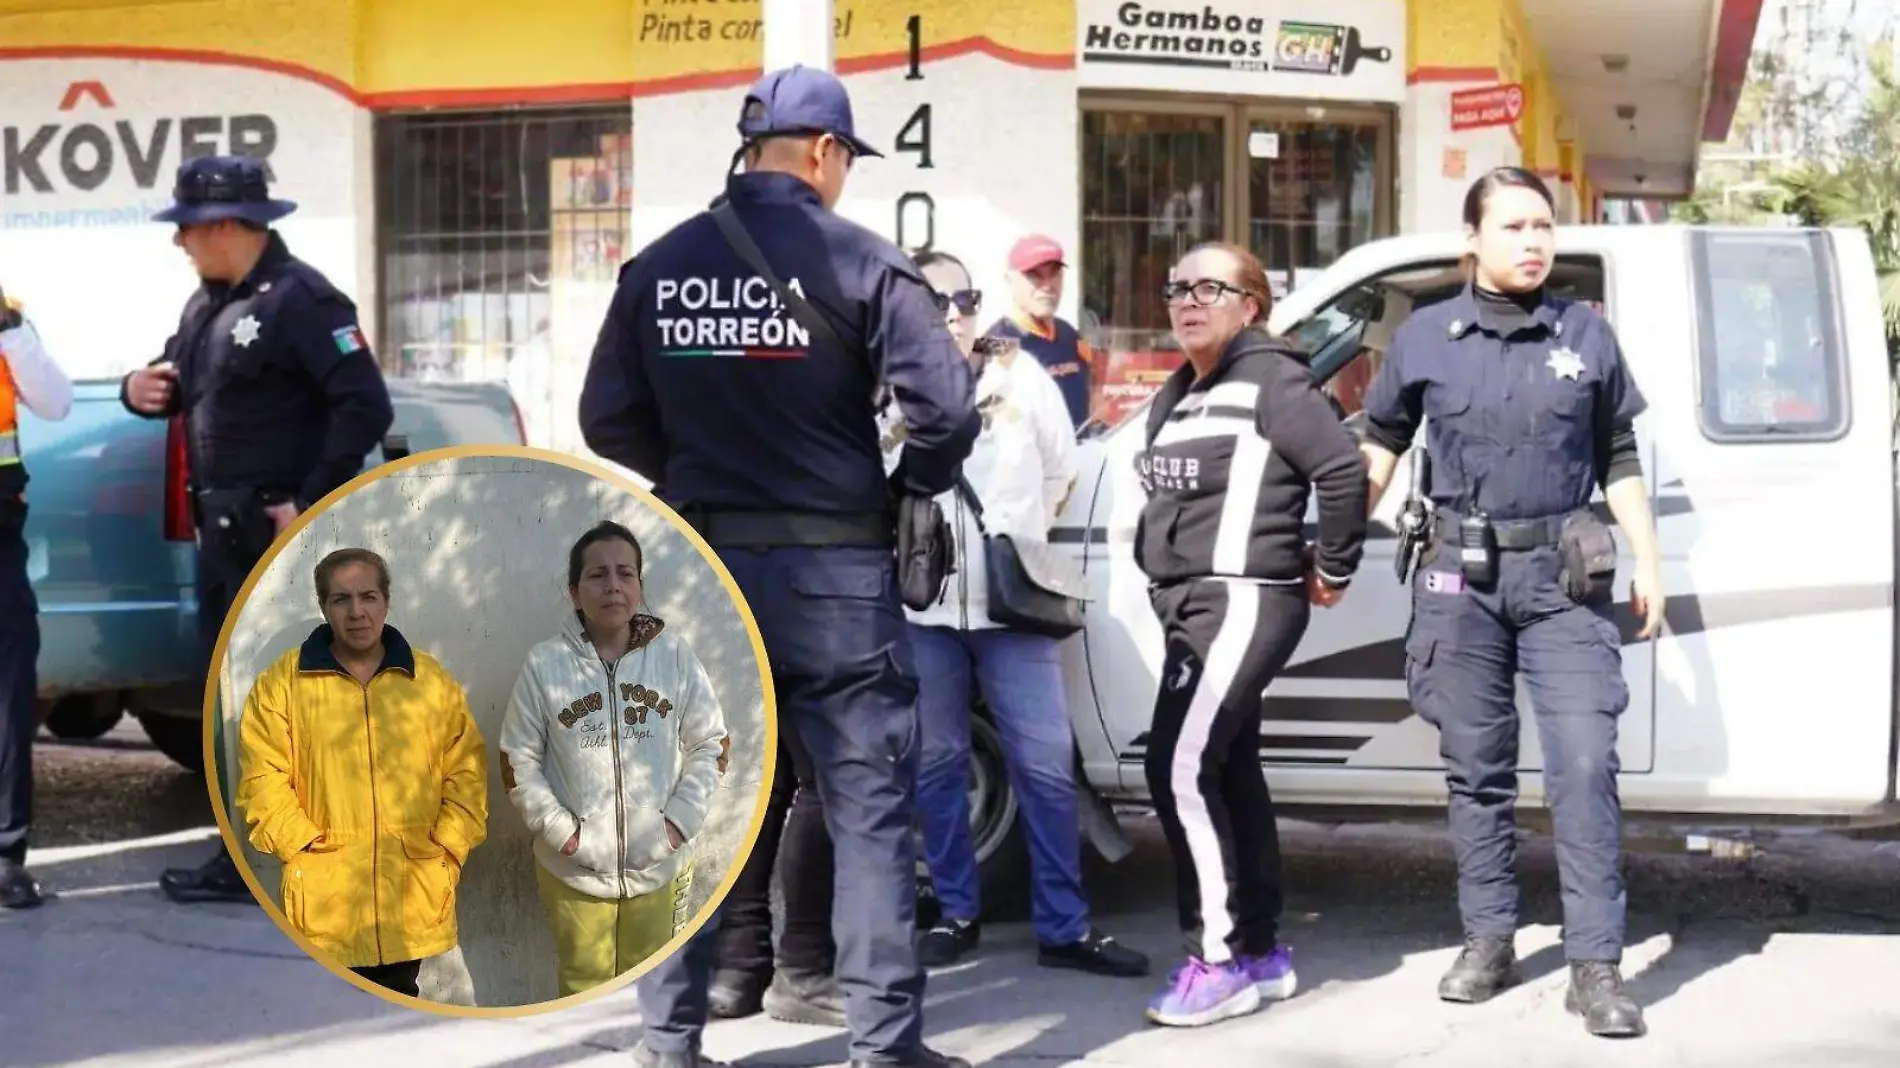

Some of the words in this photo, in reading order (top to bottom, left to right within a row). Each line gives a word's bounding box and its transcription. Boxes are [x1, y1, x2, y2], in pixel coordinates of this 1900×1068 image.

[639, 13, 712, 42] Pinta
[1118, 1, 1263, 34] Gamboa
[1085, 24, 1262, 57] Hermanos
[1279, 34, 1331, 64] GH
[656, 309, 810, 347] TORREÓN
[558, 691, 602, 729] NEW
[619, 683, 673, 719] YORK
